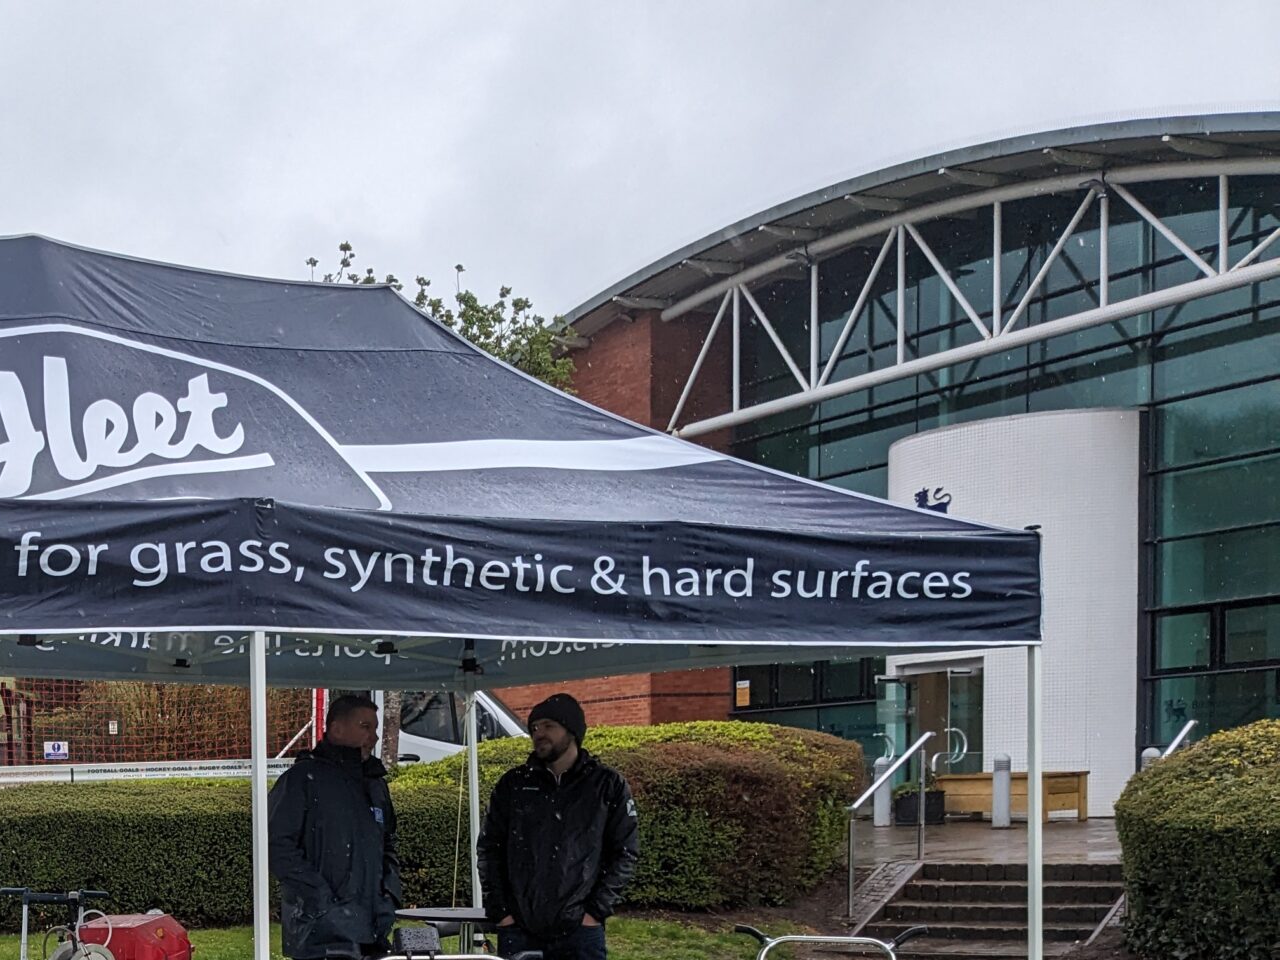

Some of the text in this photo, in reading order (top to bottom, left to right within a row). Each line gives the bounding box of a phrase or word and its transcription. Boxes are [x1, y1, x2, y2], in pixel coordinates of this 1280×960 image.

[14, 531, 109, 577] for
[129, 538, 305, 587] grass,
[322, 544, 576, 593] synthetic
[589, 554, 627, 596] &
[642, 556, 754, 598] hard
[770, 560, 973, 599] surfaces
